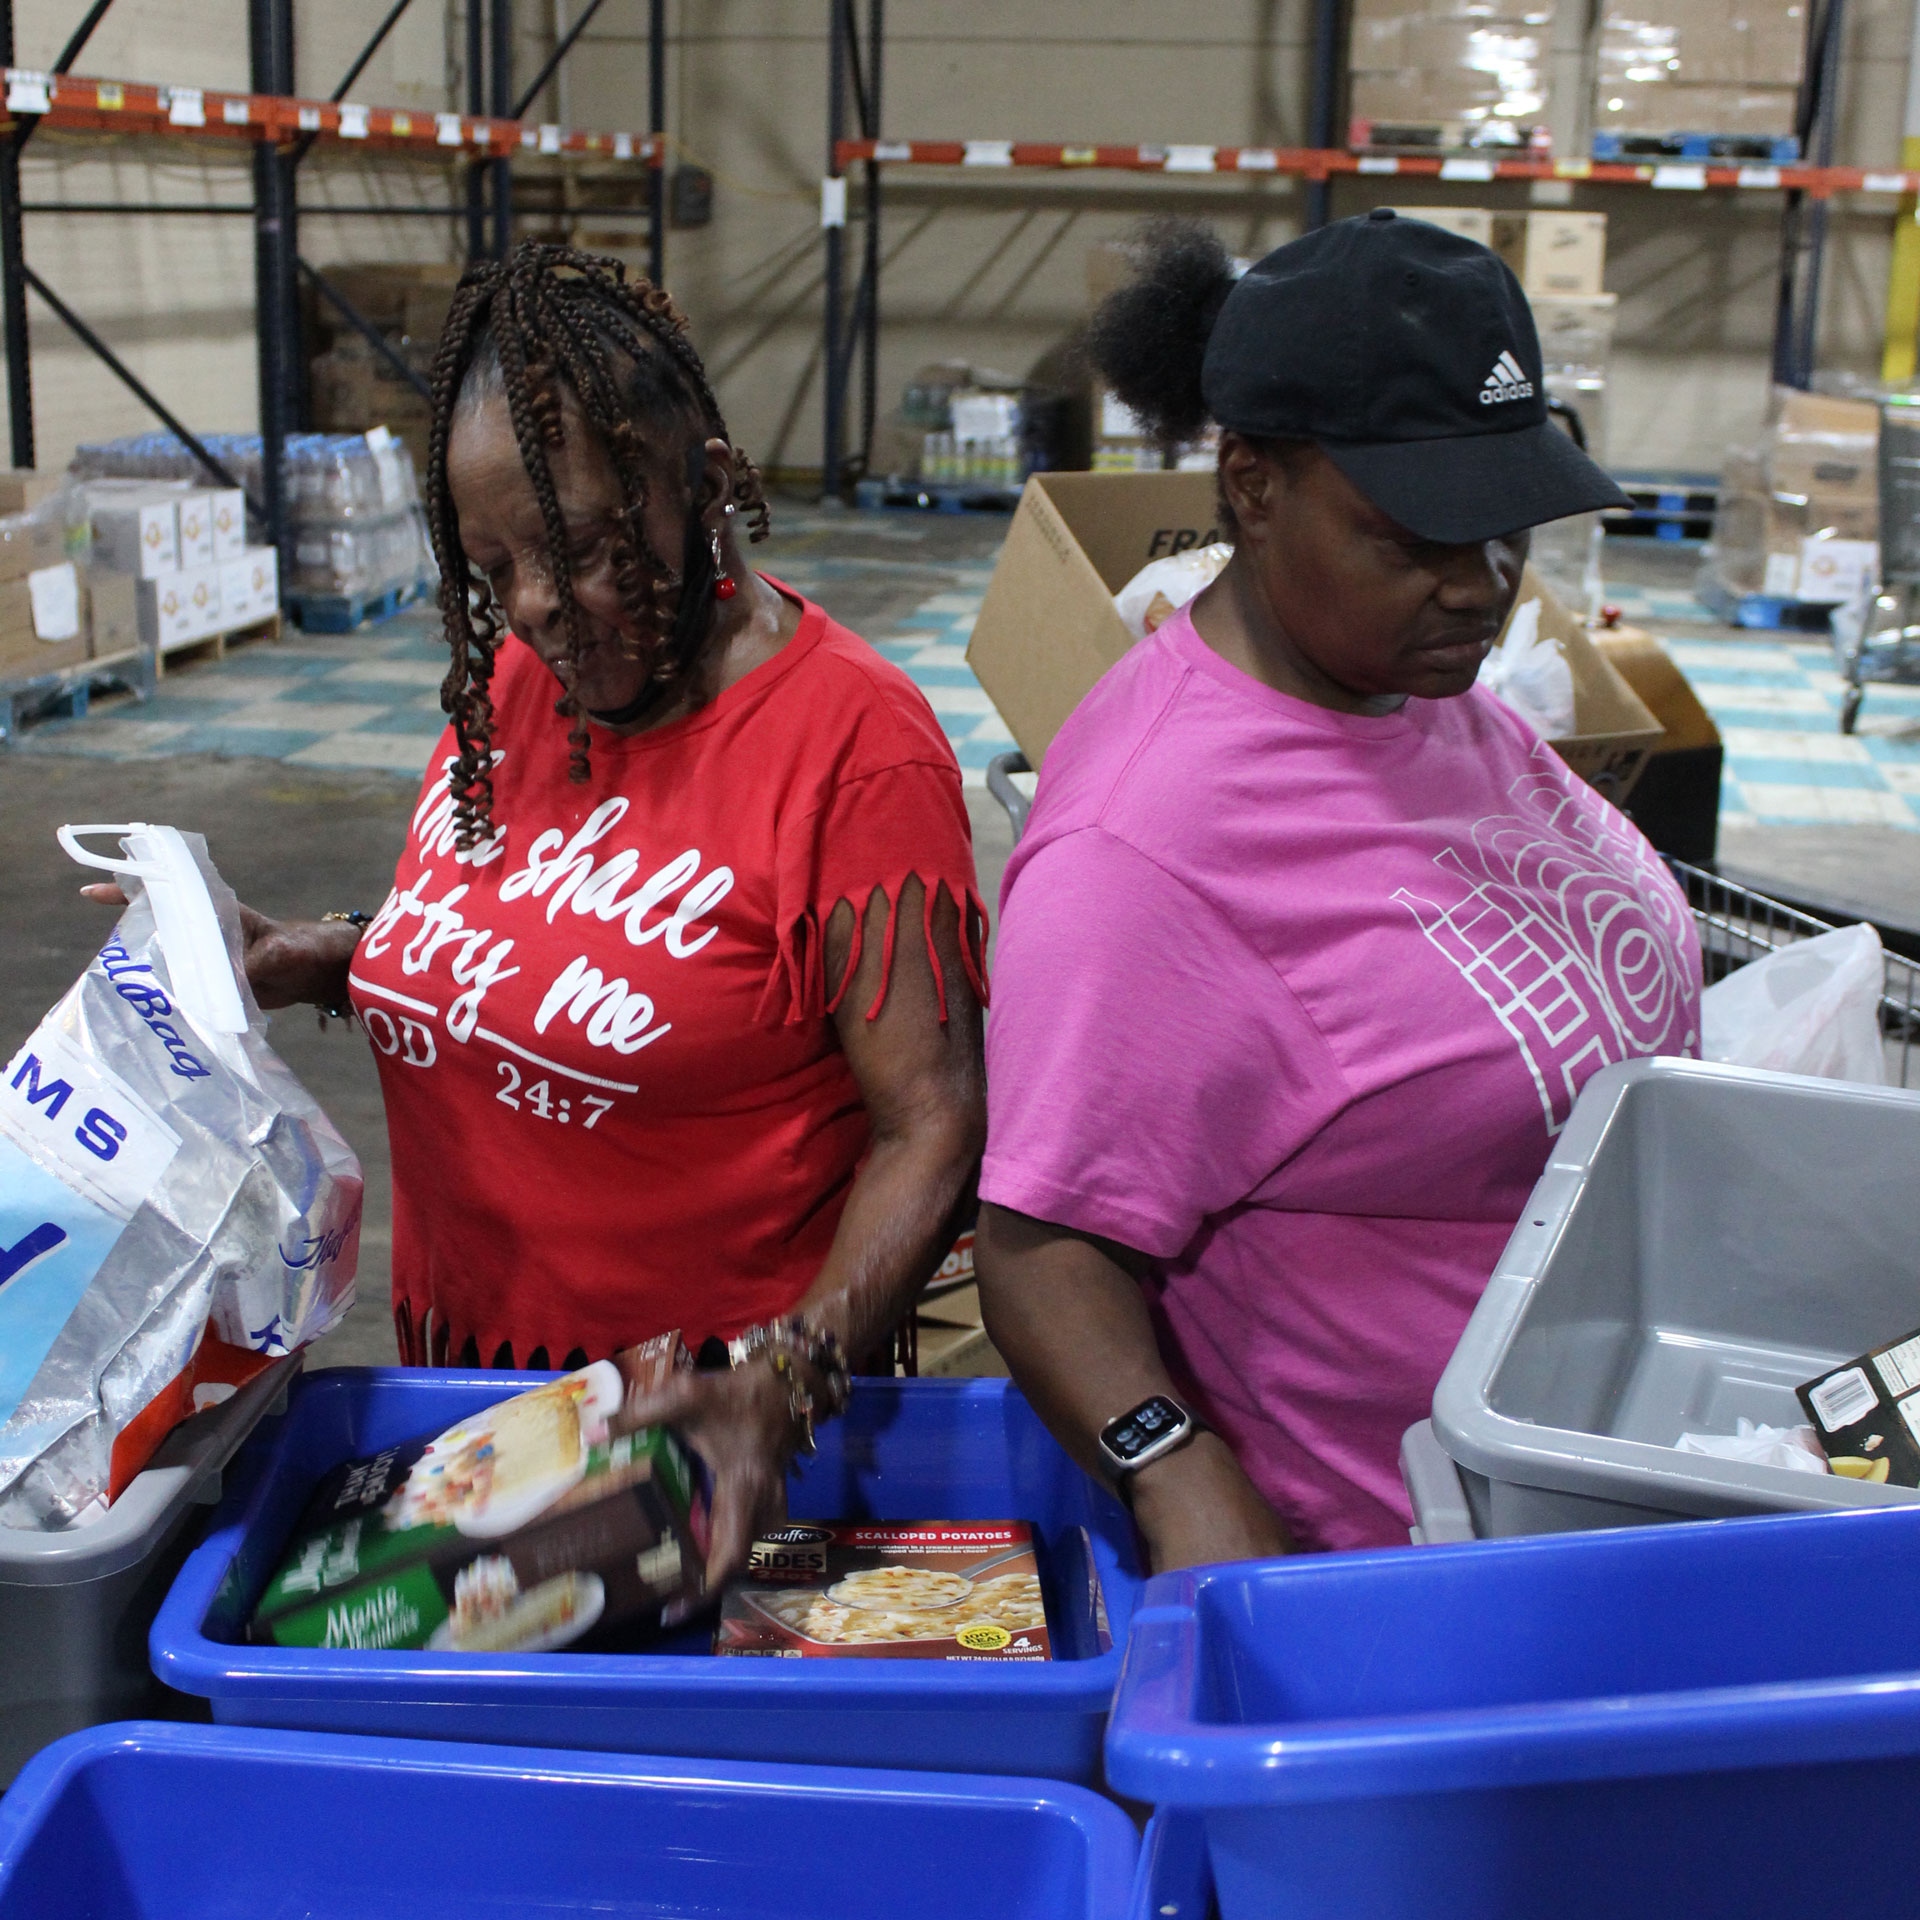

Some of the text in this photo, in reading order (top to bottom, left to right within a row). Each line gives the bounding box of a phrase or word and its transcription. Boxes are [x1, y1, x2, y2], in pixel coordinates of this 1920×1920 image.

[1479, 381, 1534, 405] adidas
[1147, 528, 1222, 558] FRA
[498, 795, 735, 959] shall
[401, 883, 520, 1044] try
[533, 954, 672, 1056] me
[116, 982, 212, 1082] Bag
[351, 1000, 615, 1130] OD 24:7
[0, 1052, 128, 1162] MS
[855, 1531, 1012, 1541] SCALLOPED POTATOES
[748, 1552, 823, 1568] SIDES
[1002, 1644, 1044, 1655] SERVINGS
[1013, 1636, 1031, 1648] 4
